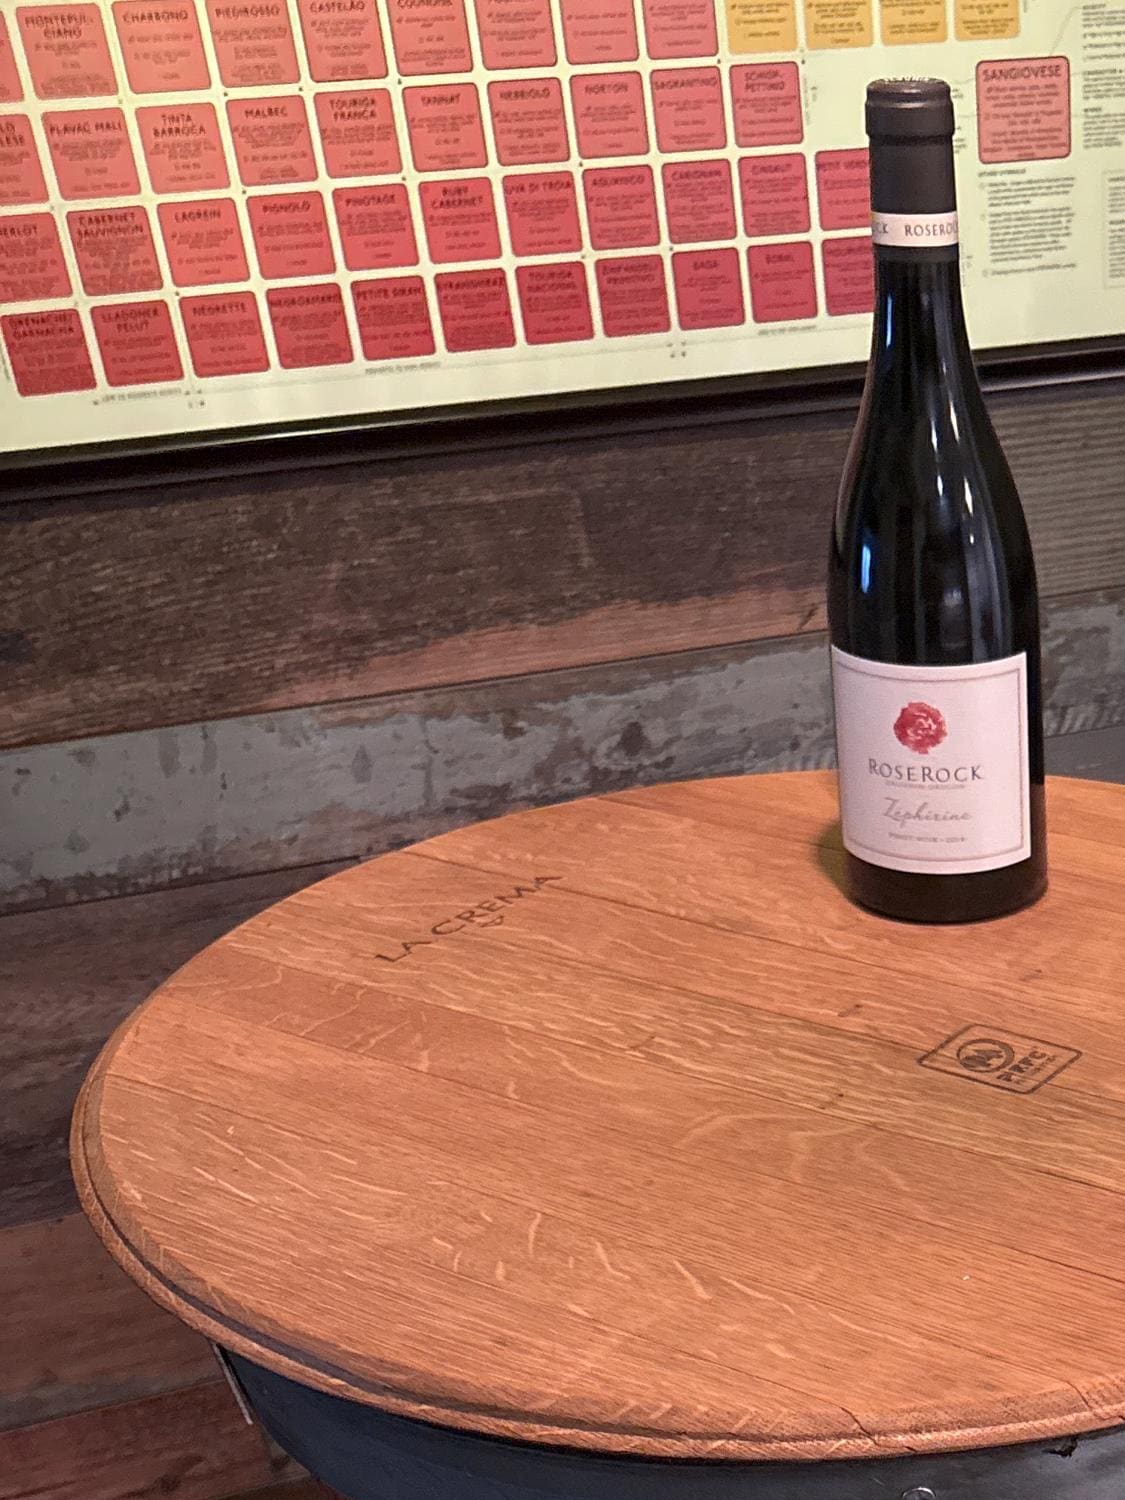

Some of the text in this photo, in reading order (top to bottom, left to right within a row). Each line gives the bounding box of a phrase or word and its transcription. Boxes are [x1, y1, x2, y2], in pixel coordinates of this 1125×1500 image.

[982, 64, 1061, 81] SANGIOVESE
[584, 82, 627, 95] NORTON
[244, 106, 287, 119] MALBEC
[345, 194, 395, 207] PINOTAGE
[431, 195, 483, 210] CABERNET
[78, 212, 135, 226] CABERNET
[375, 876, 563, 963] LA CREMA
